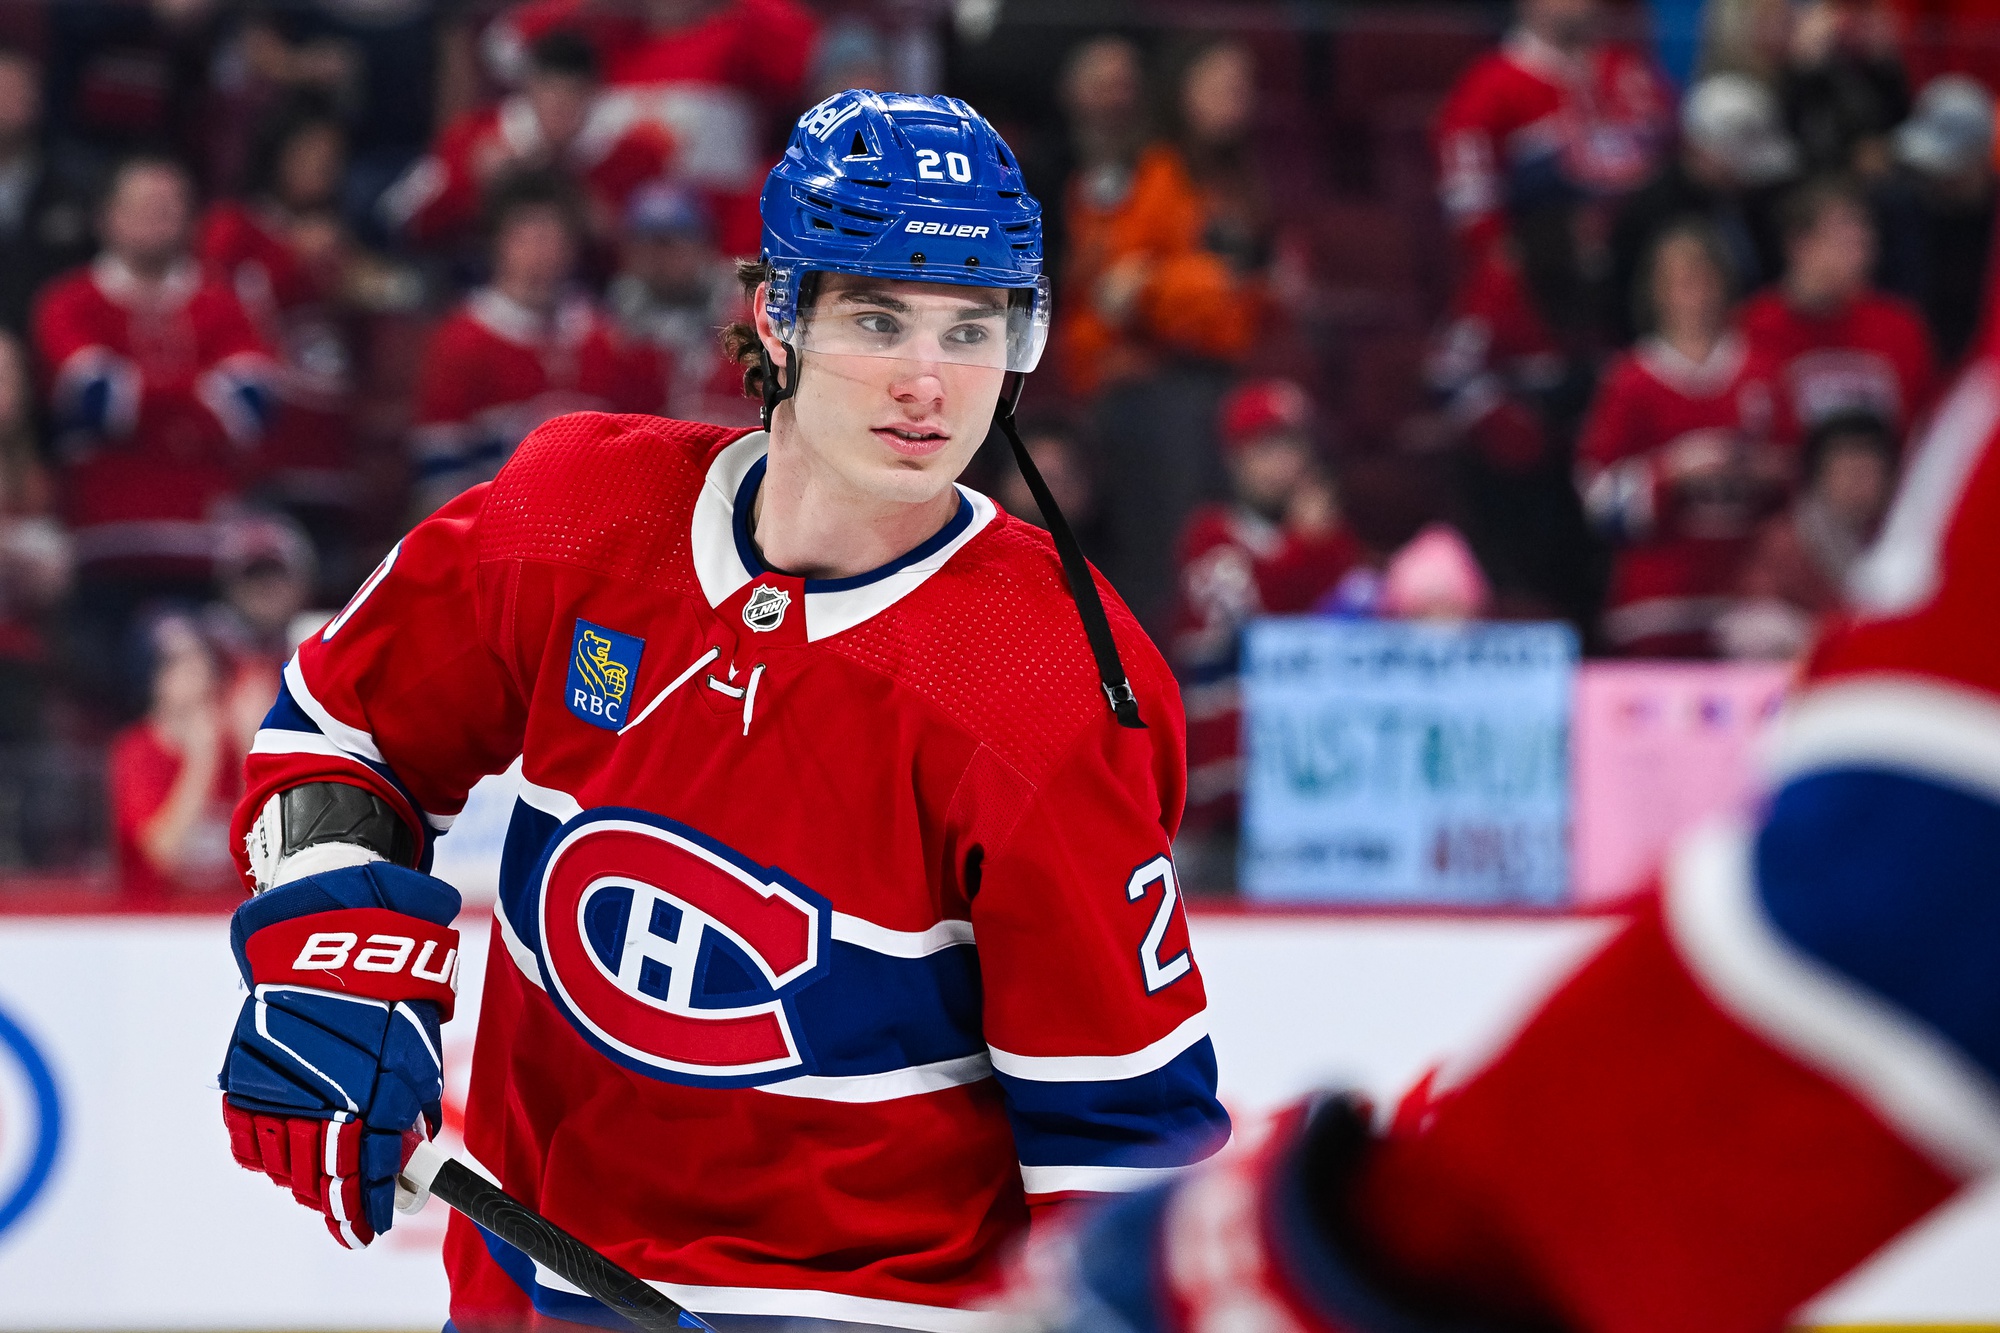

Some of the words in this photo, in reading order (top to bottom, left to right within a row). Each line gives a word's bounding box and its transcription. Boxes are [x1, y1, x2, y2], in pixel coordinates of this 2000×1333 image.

[915, 149, 972, 183] 20
[750, 600, 782, 619] LNH
[573, 688, 620, 722] RBC
[1125, 852, 1193, 997] 2
[291, 932, 460, 997] BAU
